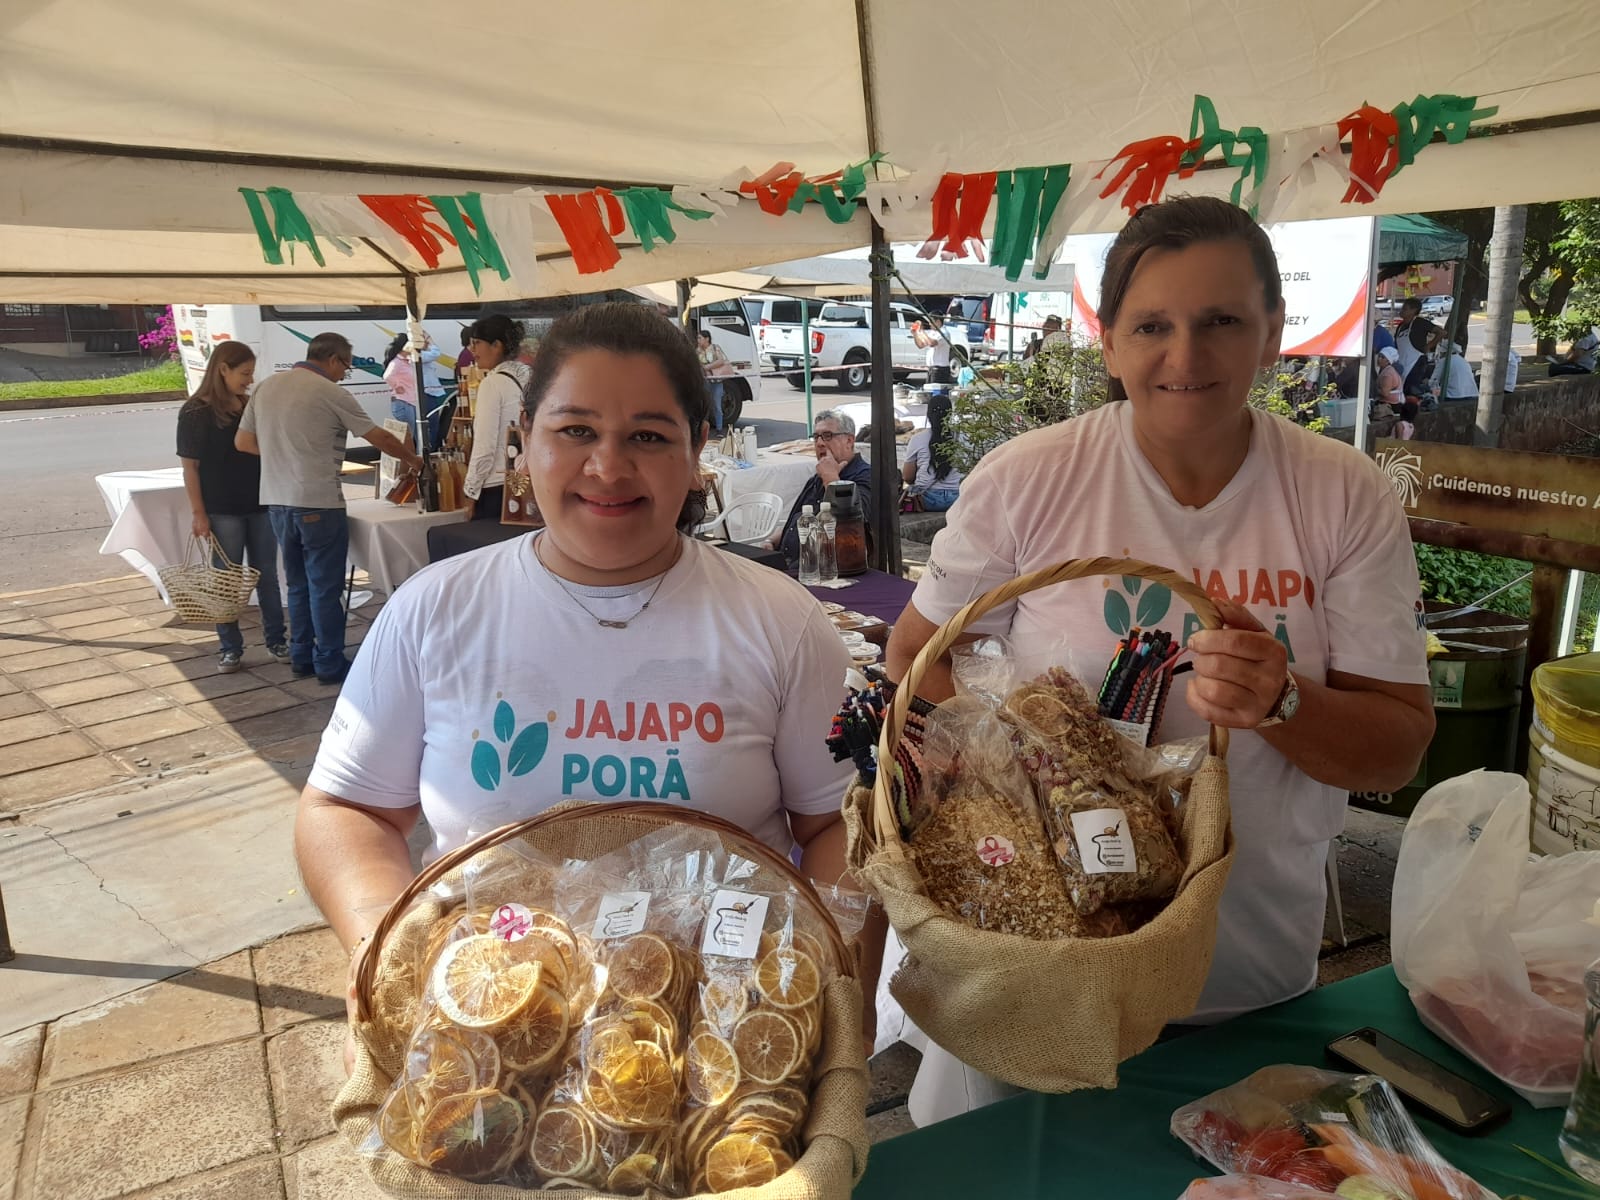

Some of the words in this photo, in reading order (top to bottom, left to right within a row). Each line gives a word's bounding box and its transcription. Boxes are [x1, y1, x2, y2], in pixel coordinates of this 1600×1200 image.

[1293, 271, 1311, 281] DEL
[1302, 315, 1309, 325] Y
[1427, 473, 1512, 498] ¡Cuidemos
[1517, 487, 1587, 507] nuestro
[565, 698, 725, 743] JAJAPO
[562, 748, 691, 800] PORÃ
